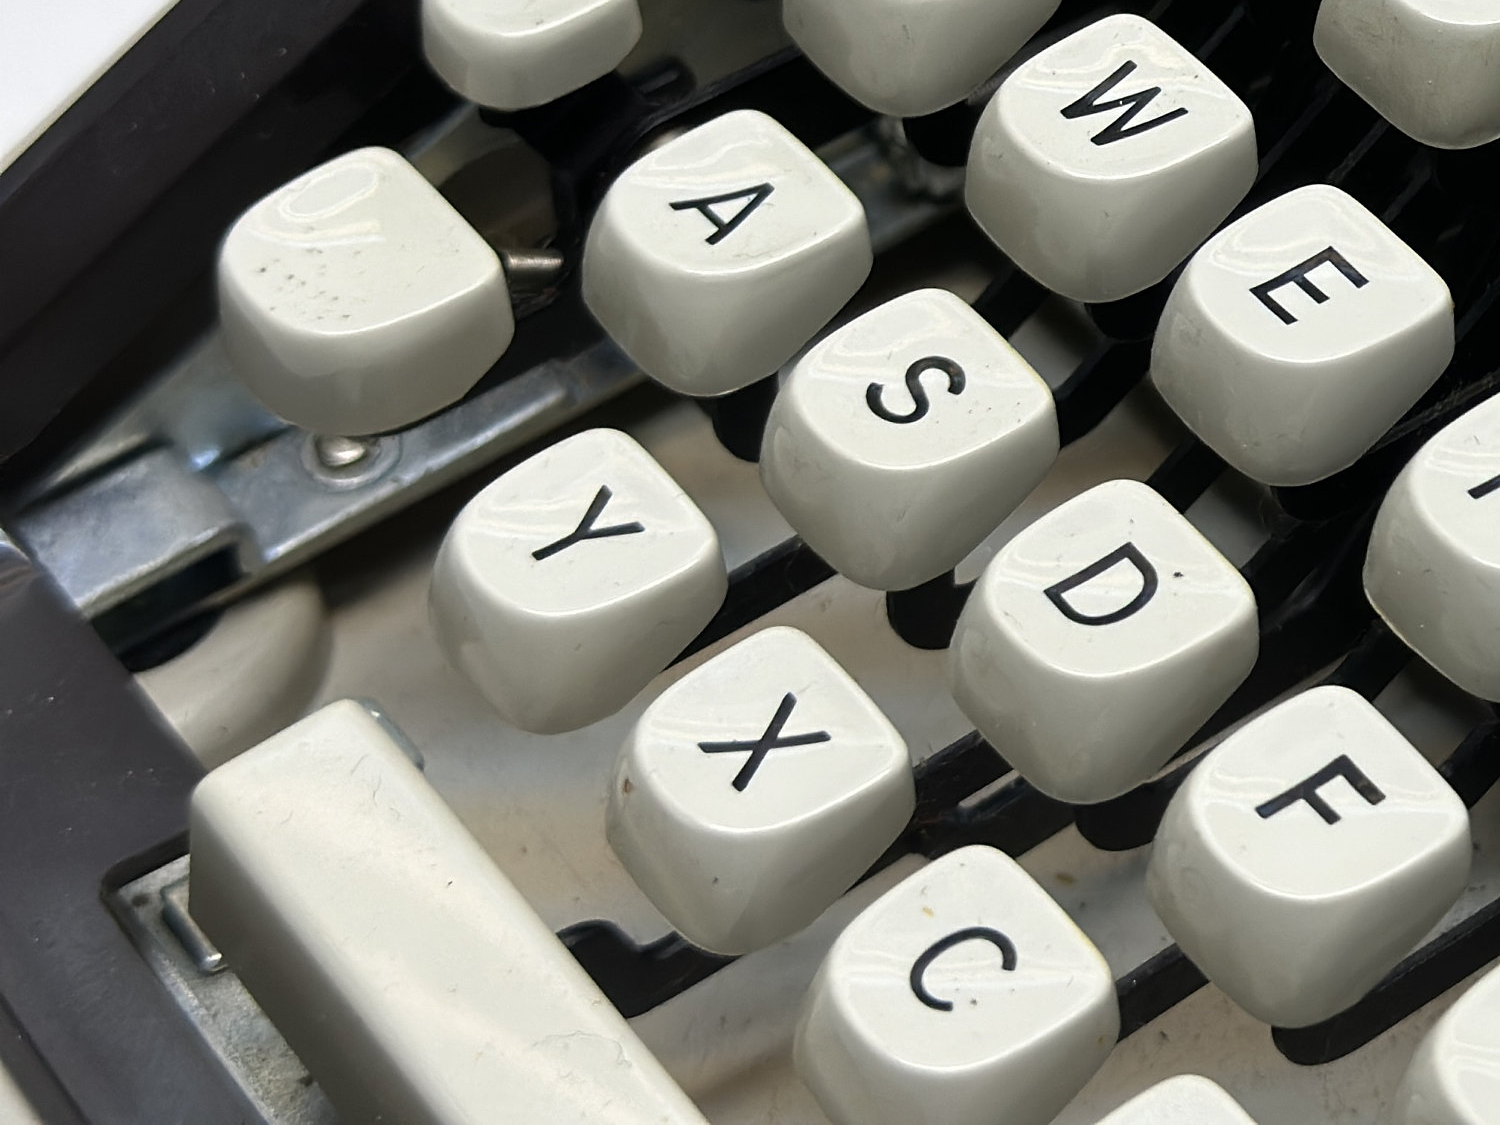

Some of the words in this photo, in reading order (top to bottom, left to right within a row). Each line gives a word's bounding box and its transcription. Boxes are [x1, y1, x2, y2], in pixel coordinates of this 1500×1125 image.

[1058, 58, 1190, 147] W
[667, 181, 776, 247] A
[1247, 244, 1371, 327] E
[864, 354, 967, 426] S
[530, 484, 646, 562] Y
[1041, 540, 1159, 628] D
[696, 691, 832, 793] X
[1253, 753, 1387, 827] F
[908, 925, 1018, 1013] C
